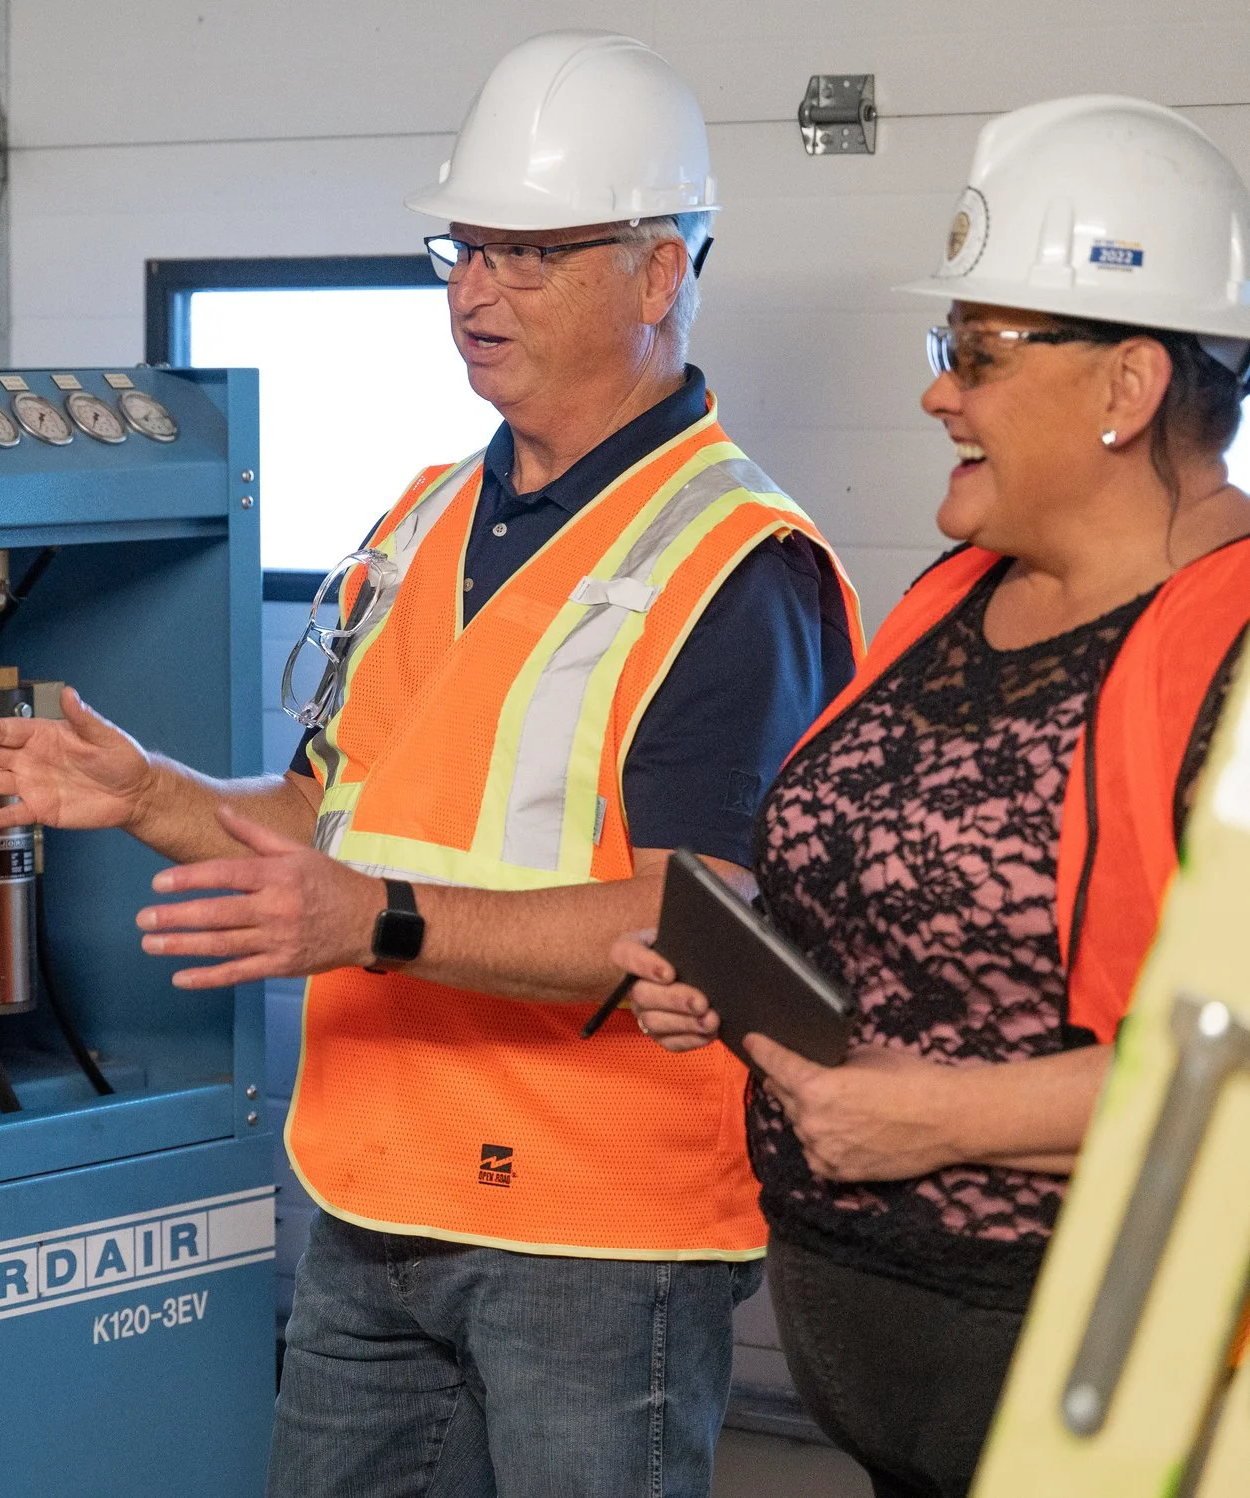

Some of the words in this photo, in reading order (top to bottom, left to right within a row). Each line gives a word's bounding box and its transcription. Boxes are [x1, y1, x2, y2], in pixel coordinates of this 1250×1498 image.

[1099, 249, 1134, 265] 2022
[478, 1170, 494, 1182] OPEN
[494, 1173, 510, 1185] ROAD
[93, 1292, 208, 1344] K120-3EV
